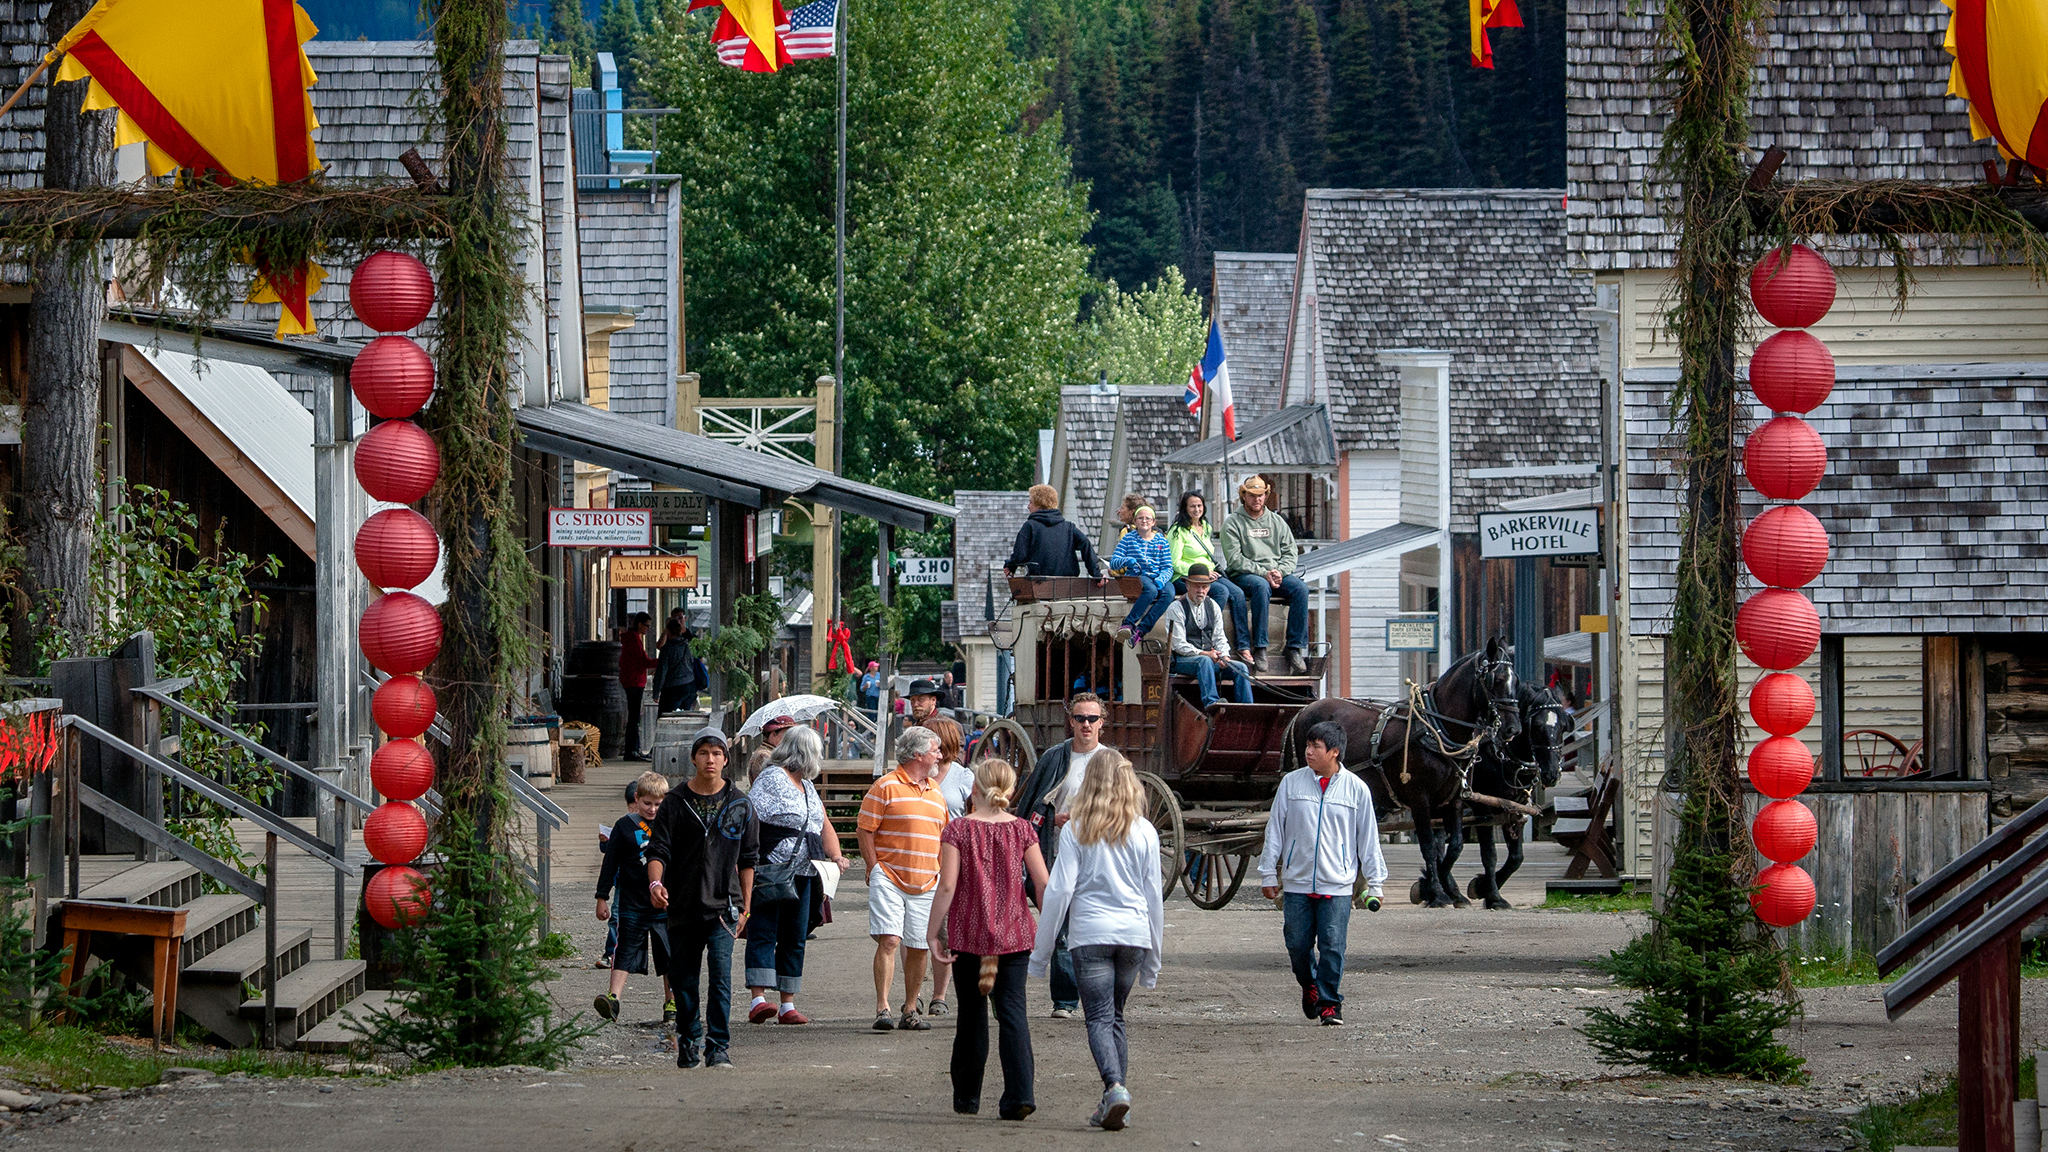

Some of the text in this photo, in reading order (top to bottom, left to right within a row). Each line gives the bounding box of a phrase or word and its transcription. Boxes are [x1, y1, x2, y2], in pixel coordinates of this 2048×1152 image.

[620, 495, 704, 509] MASON & DALY
[555, 512, 569, 526] C.
[573, 512, 645, 527] STROUSS
[1487, 515, 1592, 541] BARKERVILLE
[1511, 535, 1568, 551] HOTEL
[616, 560, 691, 570] A. McPHERN
[918, 559, 950, 573] SHO
[614, 571, 657, 582] Watchmaker
[659, 573, 665, 582] &
[906, 575, 938, 583] STOVES
